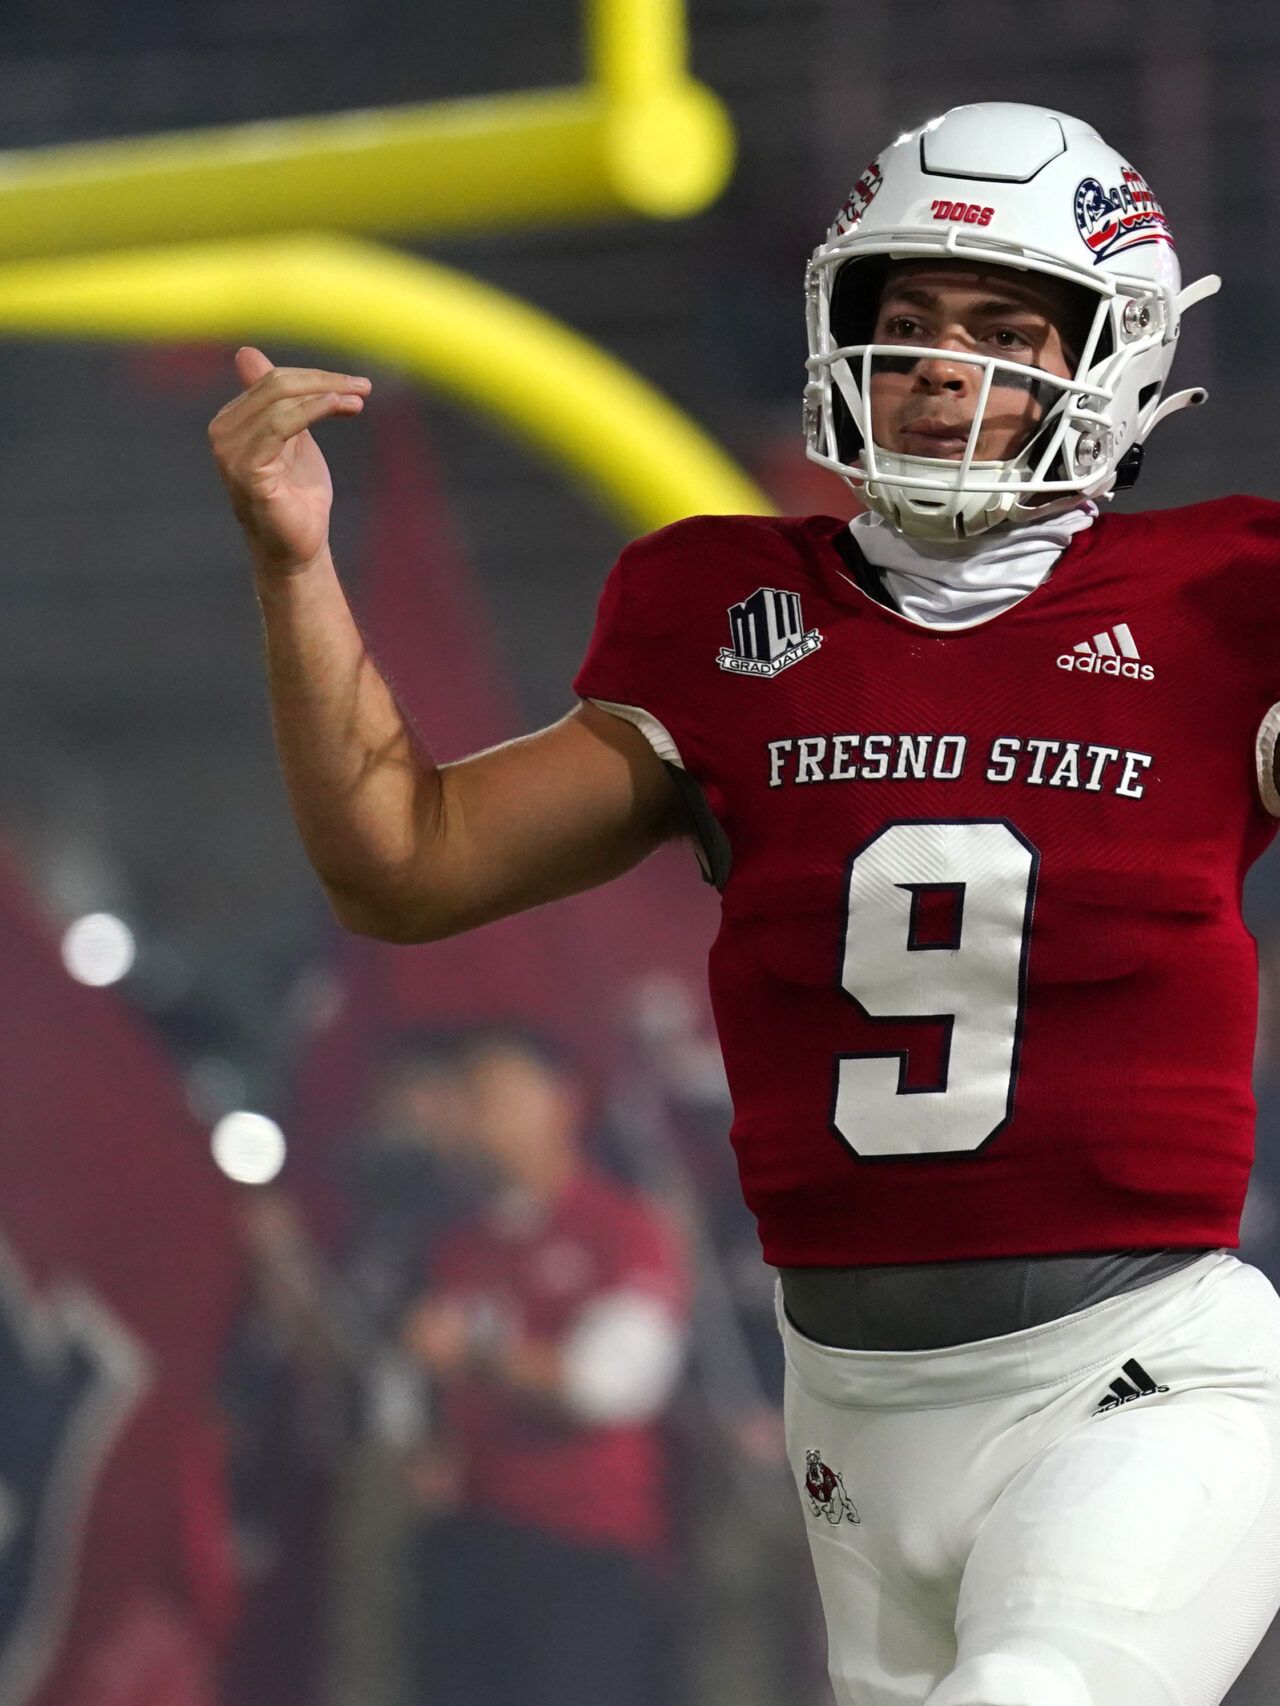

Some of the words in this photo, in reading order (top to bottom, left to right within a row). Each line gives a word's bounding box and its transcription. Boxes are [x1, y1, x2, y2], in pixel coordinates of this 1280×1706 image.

[931, 200, 995, 226] 'DOGS
[729, 642, 811, 674] GRADUATE
[1056, 650, 1155, 681] adidas
[768, 734, 967, 787] FRESNO
[986, 737, 1152, 799] STATE
[831, 820, 1037, 1160] 9
